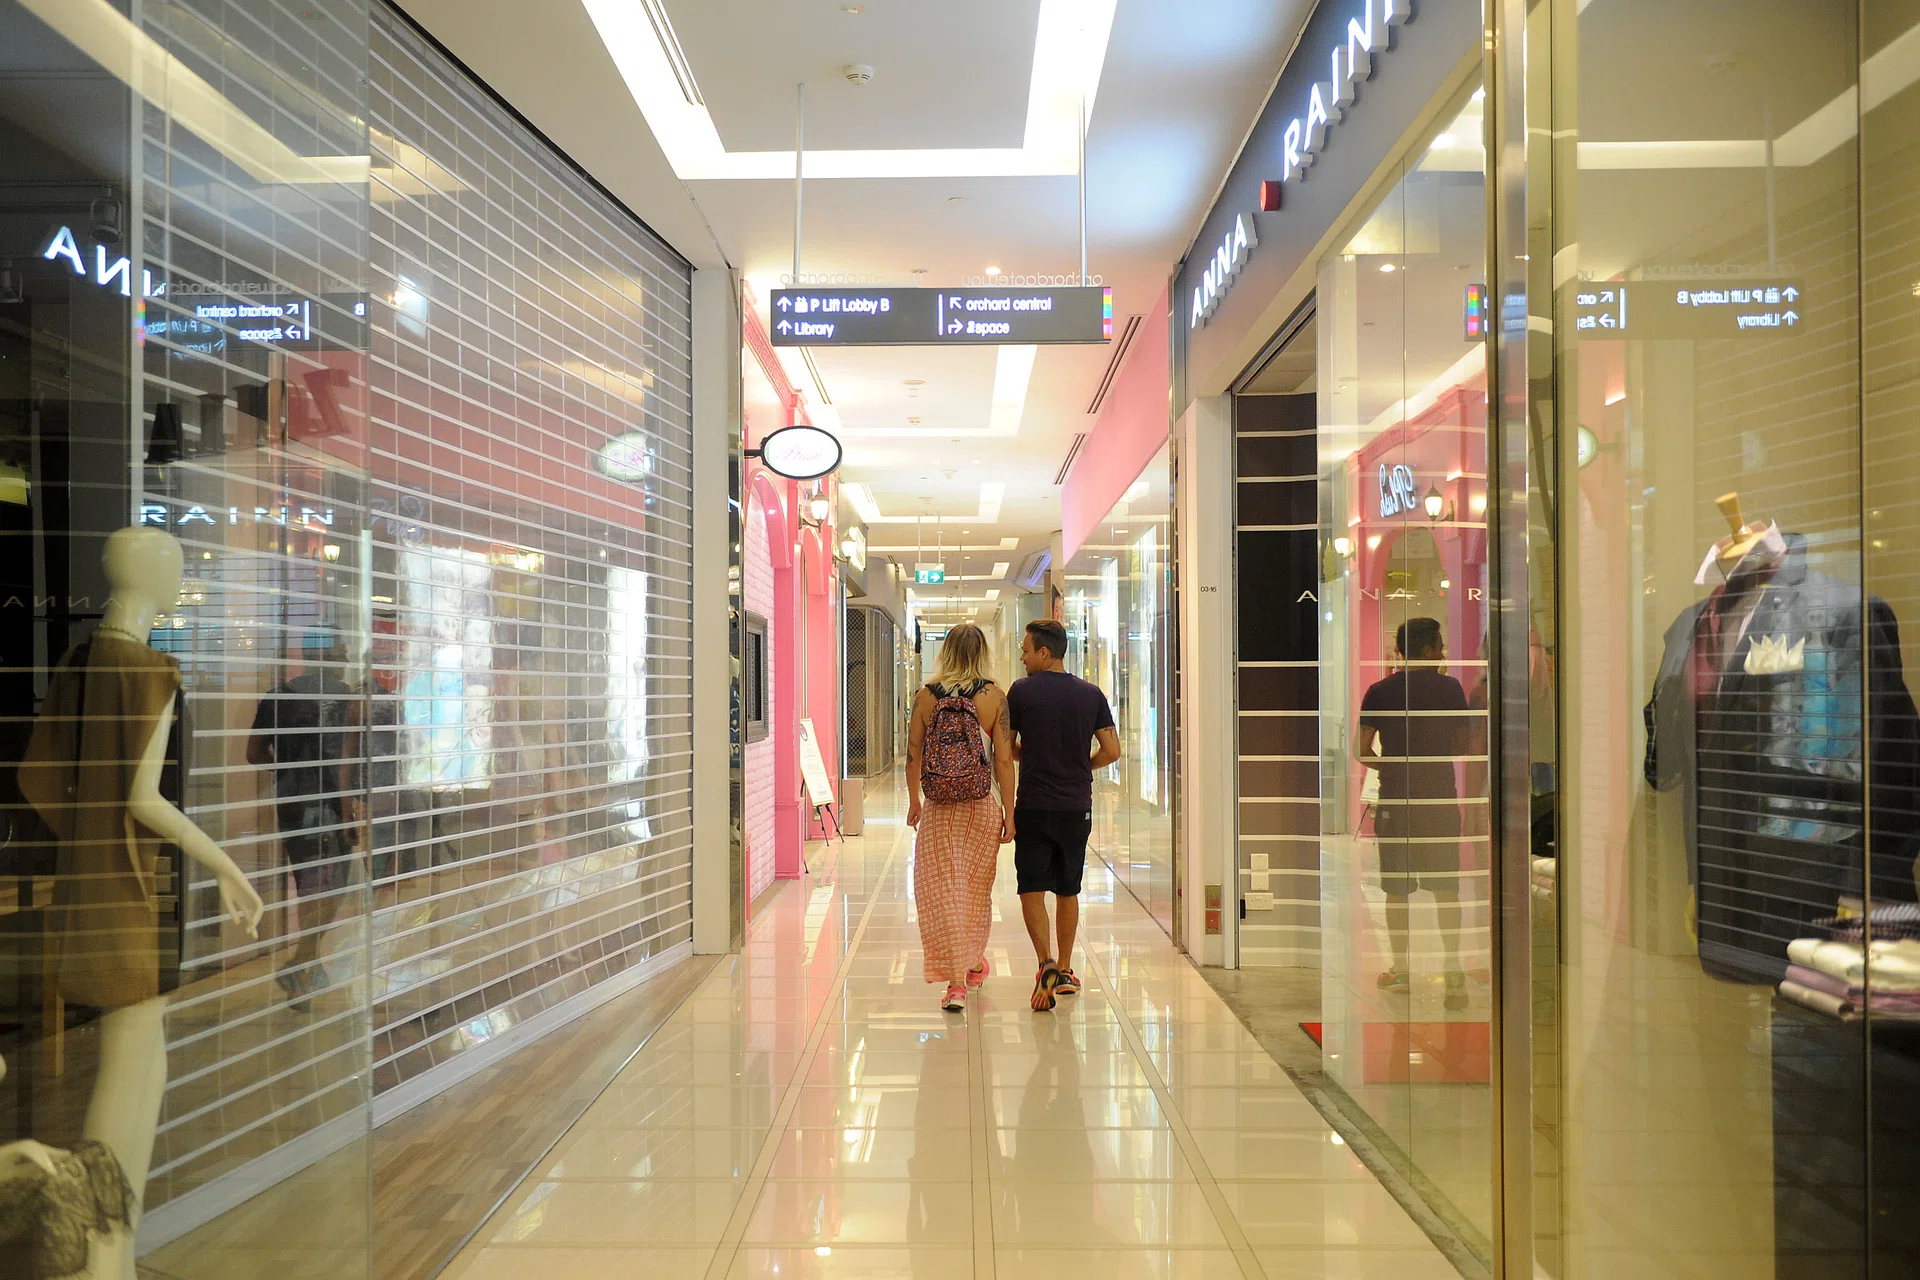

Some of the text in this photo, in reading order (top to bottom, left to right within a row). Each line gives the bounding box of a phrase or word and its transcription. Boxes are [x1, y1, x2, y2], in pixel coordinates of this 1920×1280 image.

[1191, 212, 1254, 329] ANNA
[810, 298, 890, 315] P Lift Lobby B
[966, 297, 1052, 311] orchard central
[794, 321, 834, 338] Library
[1200, 585, 1217, 593] 03-16
